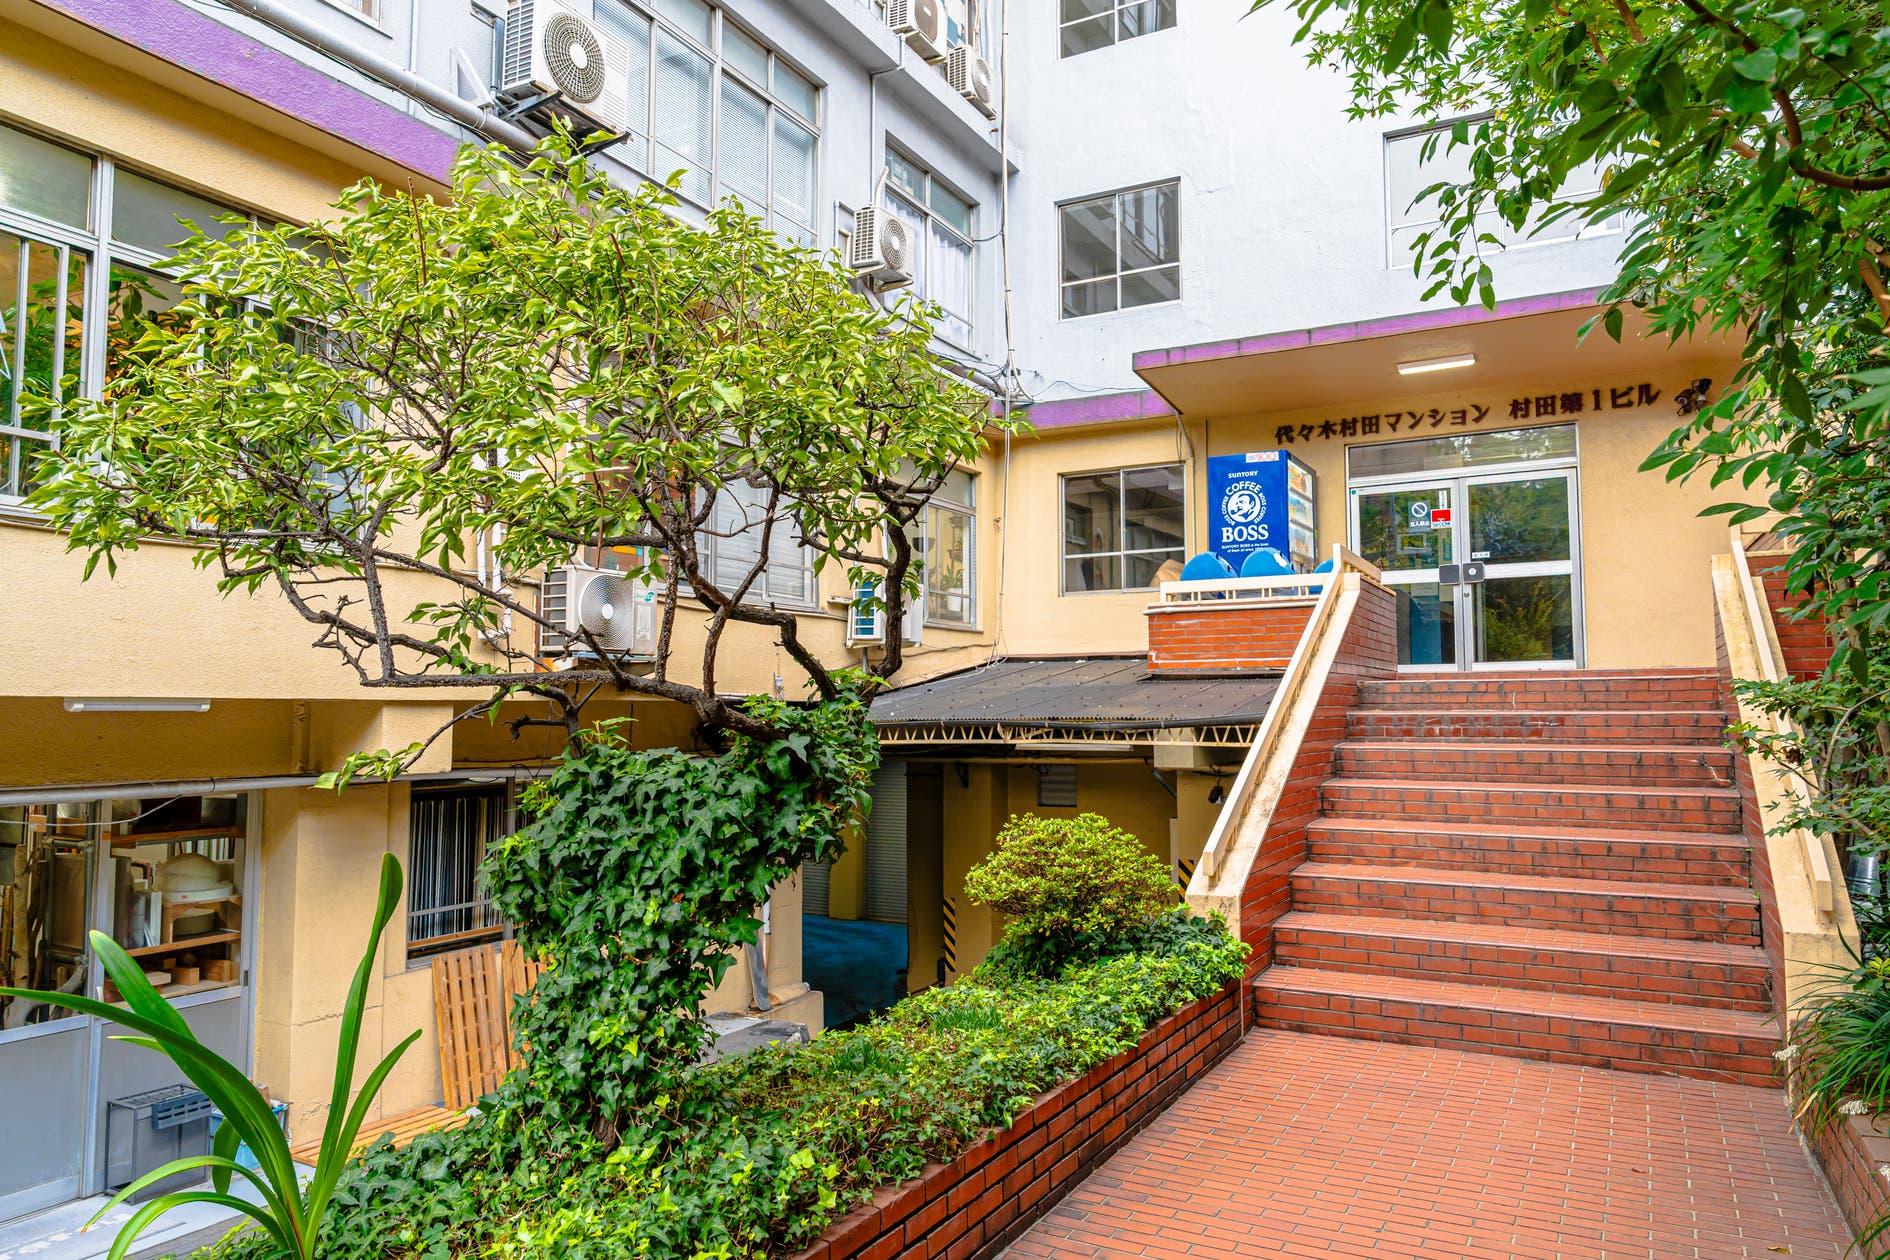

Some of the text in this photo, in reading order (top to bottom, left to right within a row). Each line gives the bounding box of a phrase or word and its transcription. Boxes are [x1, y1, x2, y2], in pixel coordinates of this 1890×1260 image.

[1275, 384, 1661, 445] 代々木村田マンション 村田第1ビル
[1226, 481, 1262, 495] COFFEE
[1221, 524, 1269, 542] BOSS
